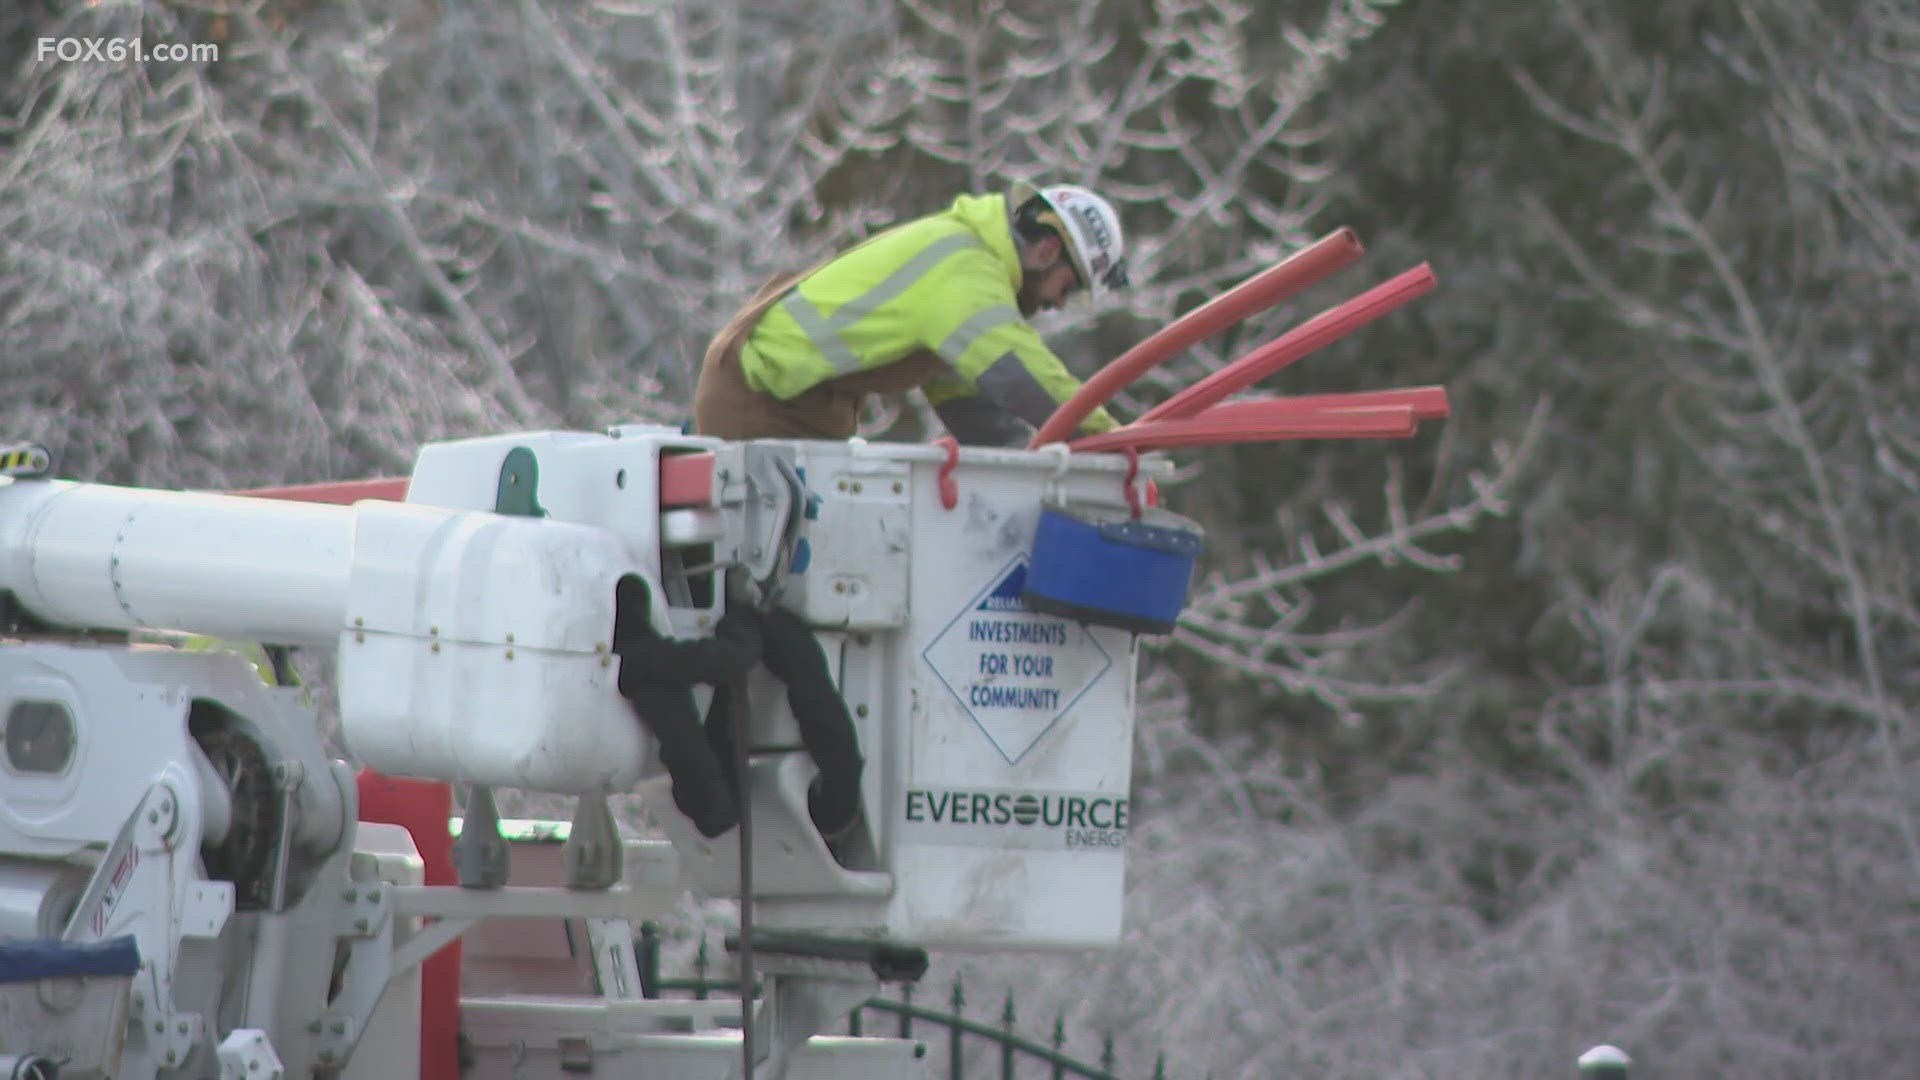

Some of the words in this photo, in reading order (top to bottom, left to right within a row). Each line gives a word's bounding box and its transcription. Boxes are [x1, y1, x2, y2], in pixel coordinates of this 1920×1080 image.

[969, 621, 1067, 645] INVESTMENTS
[980, 653, 1008, 675] FOR
[1013, 654, 1054, 677] YOUR
[970, 685, 1060, 710] COMMUNITY
[906, 791, 1129, 829] EVERSOURCE
